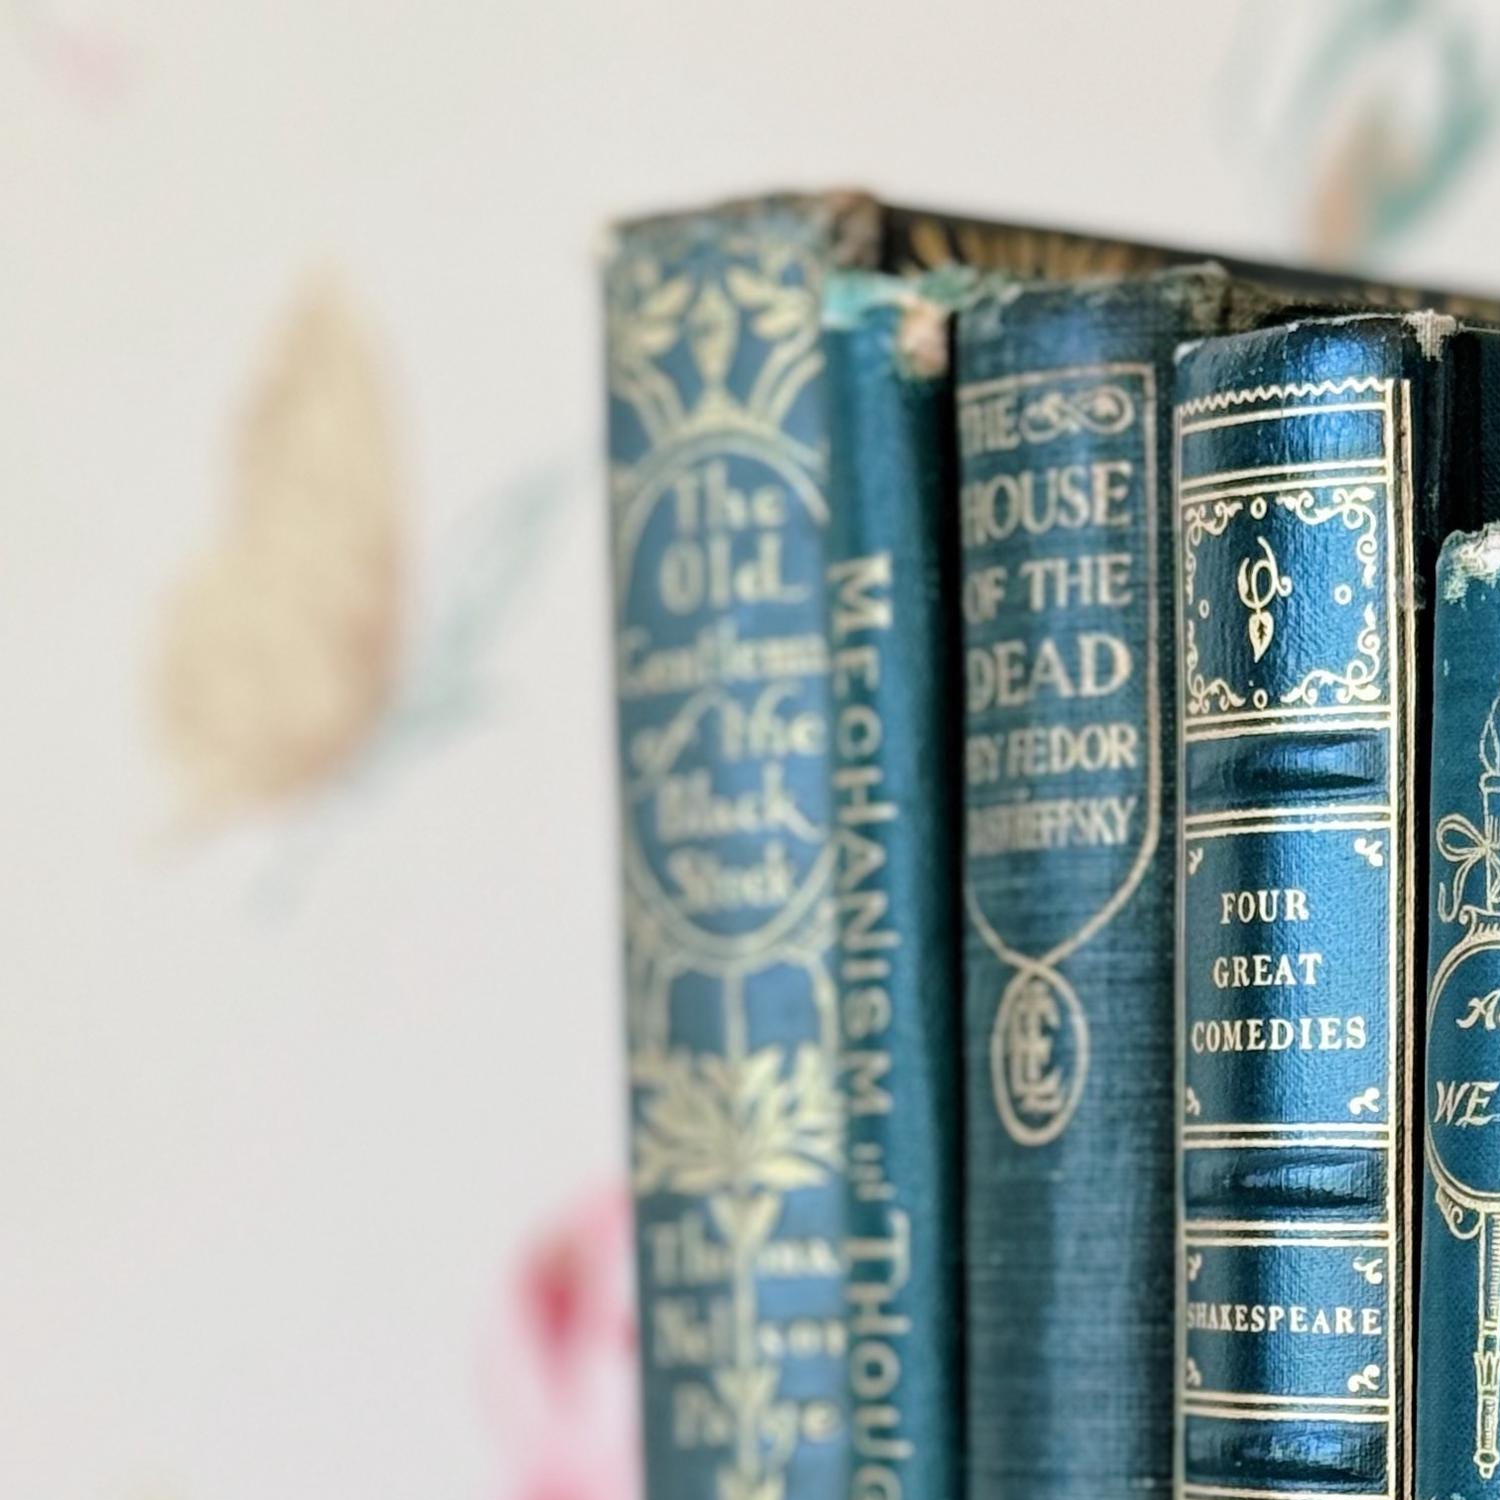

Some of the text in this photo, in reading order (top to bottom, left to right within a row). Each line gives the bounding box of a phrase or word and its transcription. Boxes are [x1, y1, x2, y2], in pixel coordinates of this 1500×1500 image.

[960, 460, 1133, 546] HOUSE
[1019, 553, 1133, 612] THE
[966, 632, 1134, 713] DEAD
[1007, 722, 1138, 779] FEDOR
[826, 552, 897, 1116] MECHANISM
[1220, 889, 1310, 925] FOUR
[1212, 951, 1322, 989] GREAT
[1191, 1015, 1368, 1053] COMEDIES
[1432, 1081, 1500, 1128] WE
[1186, 1303, 1382, 1336] SHAKESPEARE
